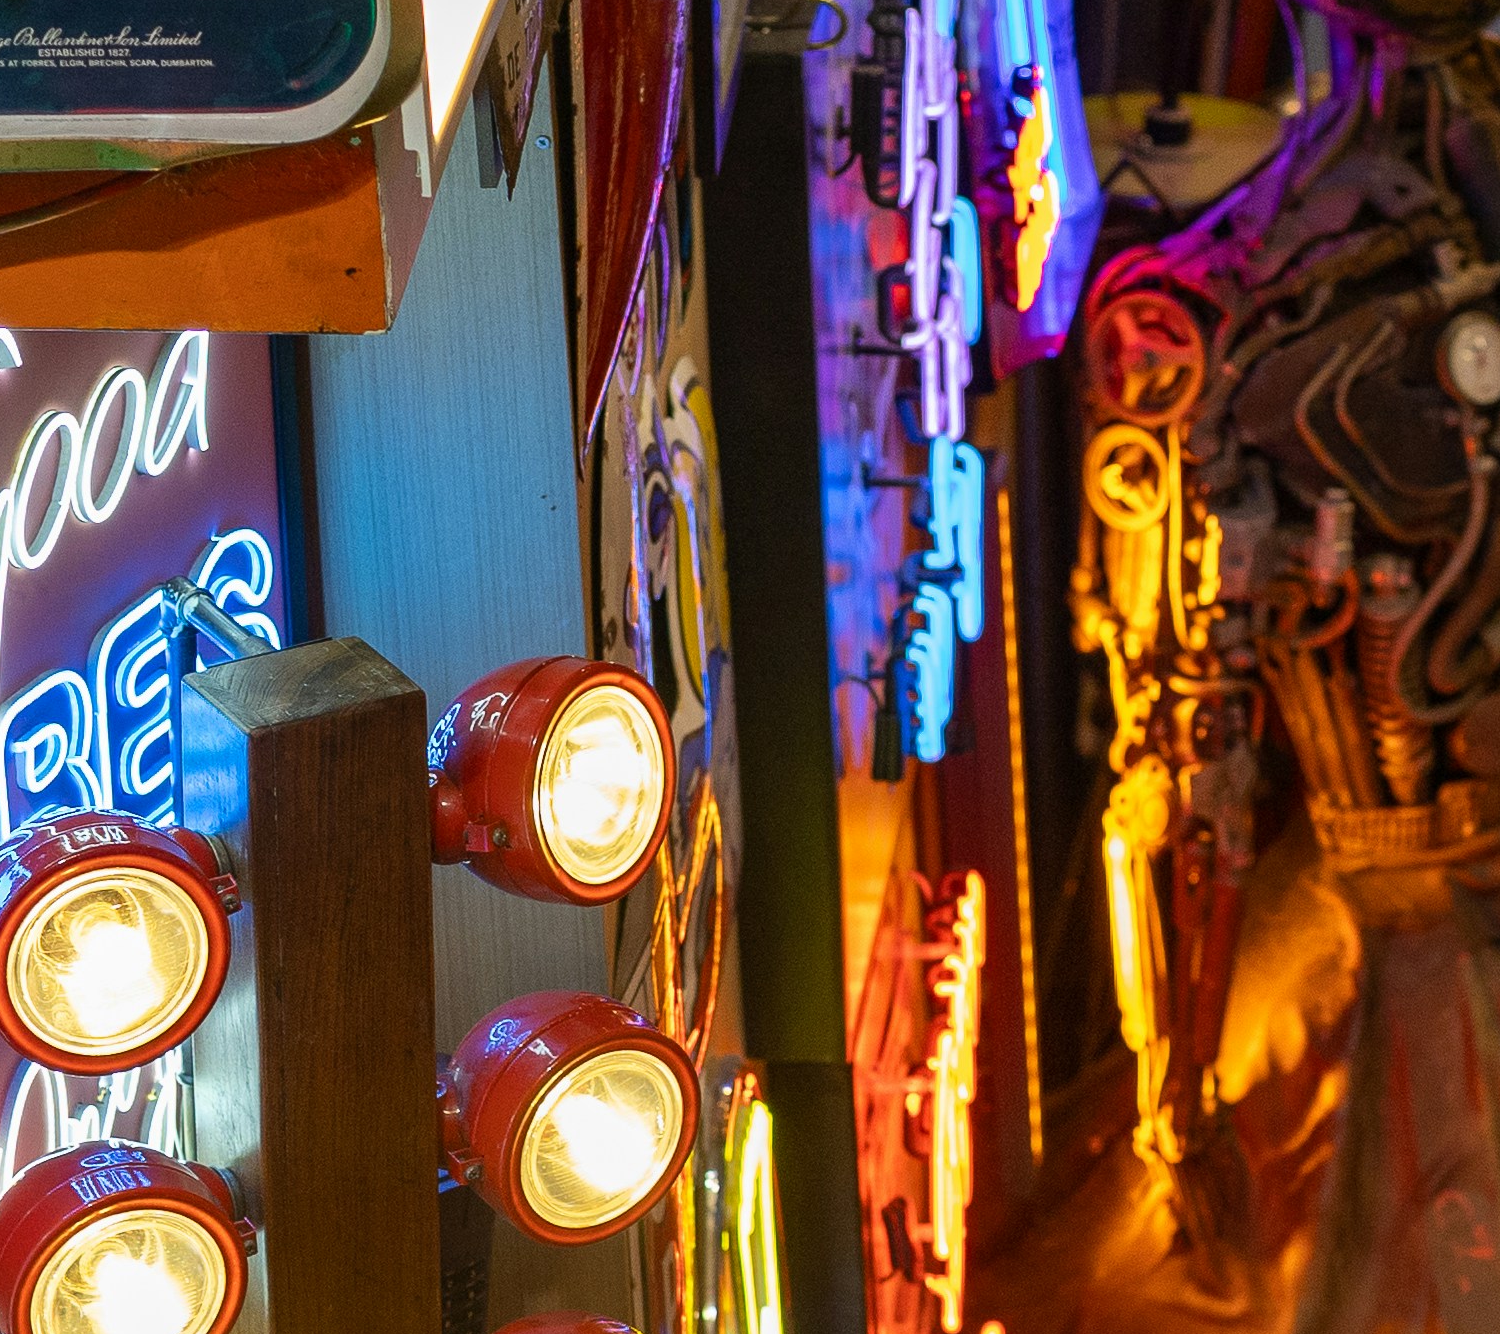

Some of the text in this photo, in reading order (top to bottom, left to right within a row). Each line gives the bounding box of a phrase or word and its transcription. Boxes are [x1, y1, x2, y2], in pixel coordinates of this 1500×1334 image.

[141, 25, 203, 47] Limited
[37, 47, 105, 58] ESTABLISHED
[7, 58, 19, 68] AT
